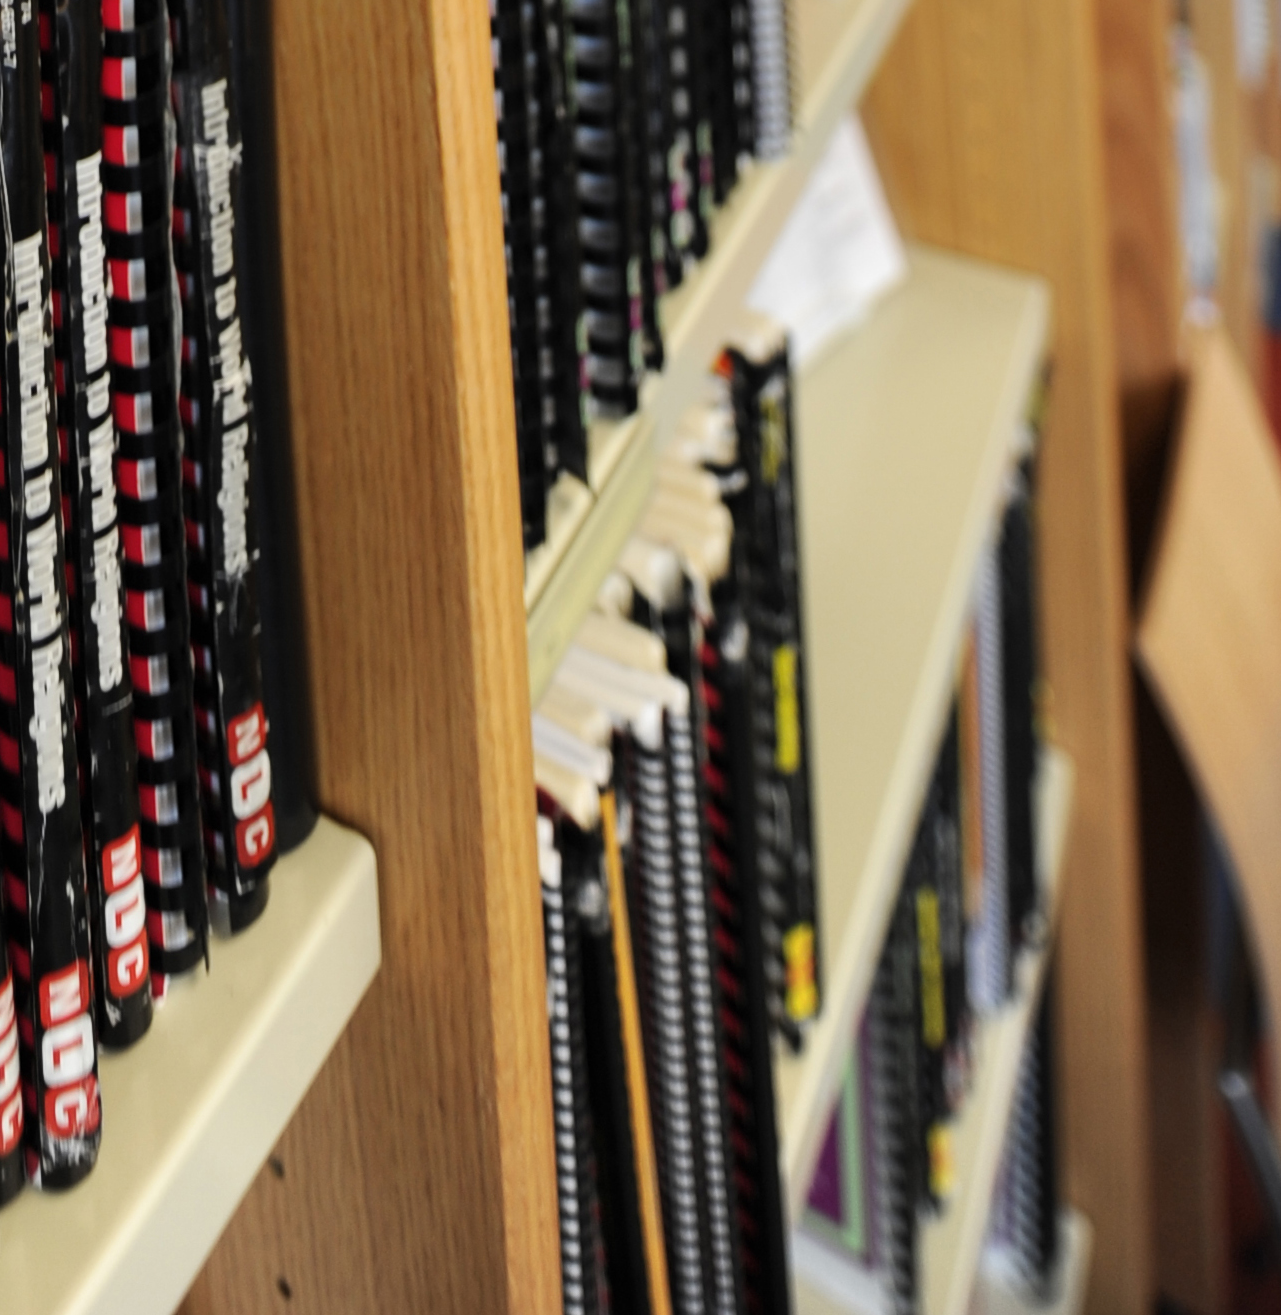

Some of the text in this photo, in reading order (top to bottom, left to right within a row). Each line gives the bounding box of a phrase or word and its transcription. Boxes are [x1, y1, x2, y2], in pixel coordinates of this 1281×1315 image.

[214, 276, 237, 320] to
[76, 150, 124, 693] Introduction to World Religions
[13, 231, 66, 813] Introduction to World Religions
[231, 708, 273, 862] NLC
[106, 830, 147, 993] NLC
[42, 963, 92, 1134] NLC
